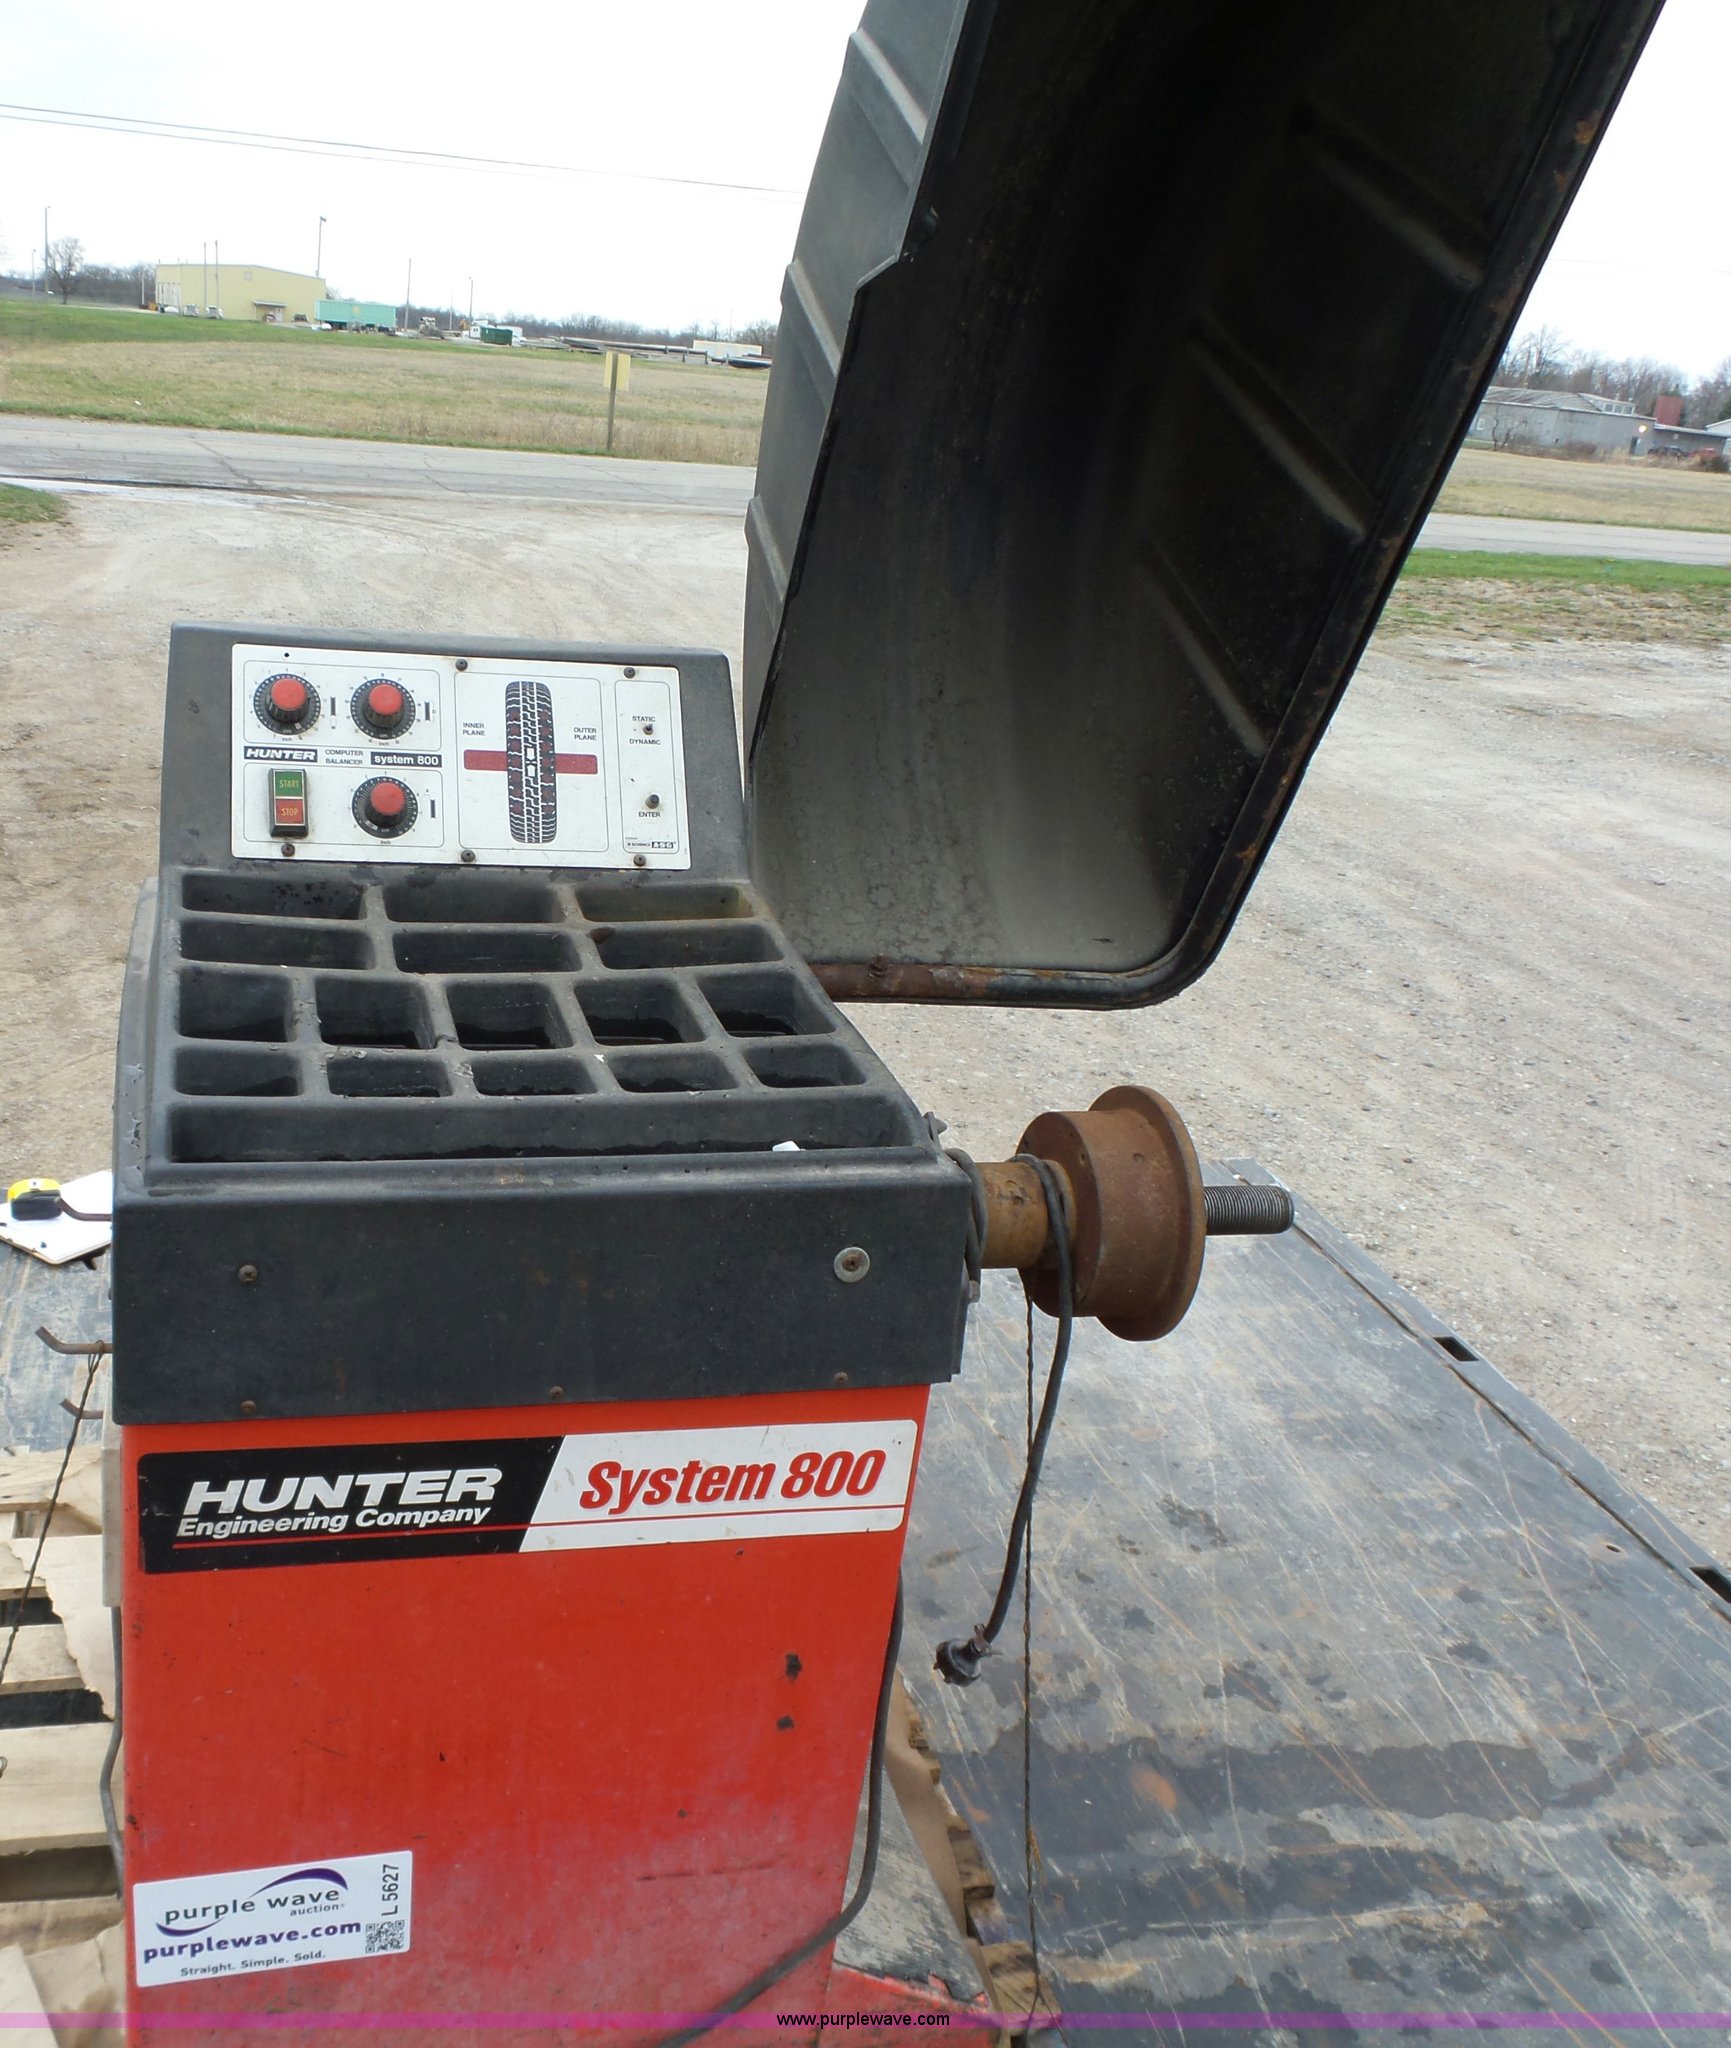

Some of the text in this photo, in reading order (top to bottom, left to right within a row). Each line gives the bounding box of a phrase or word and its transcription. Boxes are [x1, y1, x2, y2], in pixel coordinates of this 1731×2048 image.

[632, 715, 656, 723] STATIC
[629, 738, 661, 746] DYNAMIC
[246, 748, 316, 761] HUNTER
[325, 749, 364, 757] COMPUTER
[374, 755, 439, 766] system 800
[279, 779, 299, 789] START
[281, 807, 299, 818] STOP
[185, 1467, 503, 1514] HUNTER
[579, 1450, 885, 1514] System 800
[176, 1505, 491, 1539] Engineering Company
[382, 1864, 399, 1916] L 5627
[165, 1888, 340, 1925] purple wave
[143, 1920, 361, 1964] purplewave.com
[180, 1950, 326, 1977] Straight. Simple. Sold.
